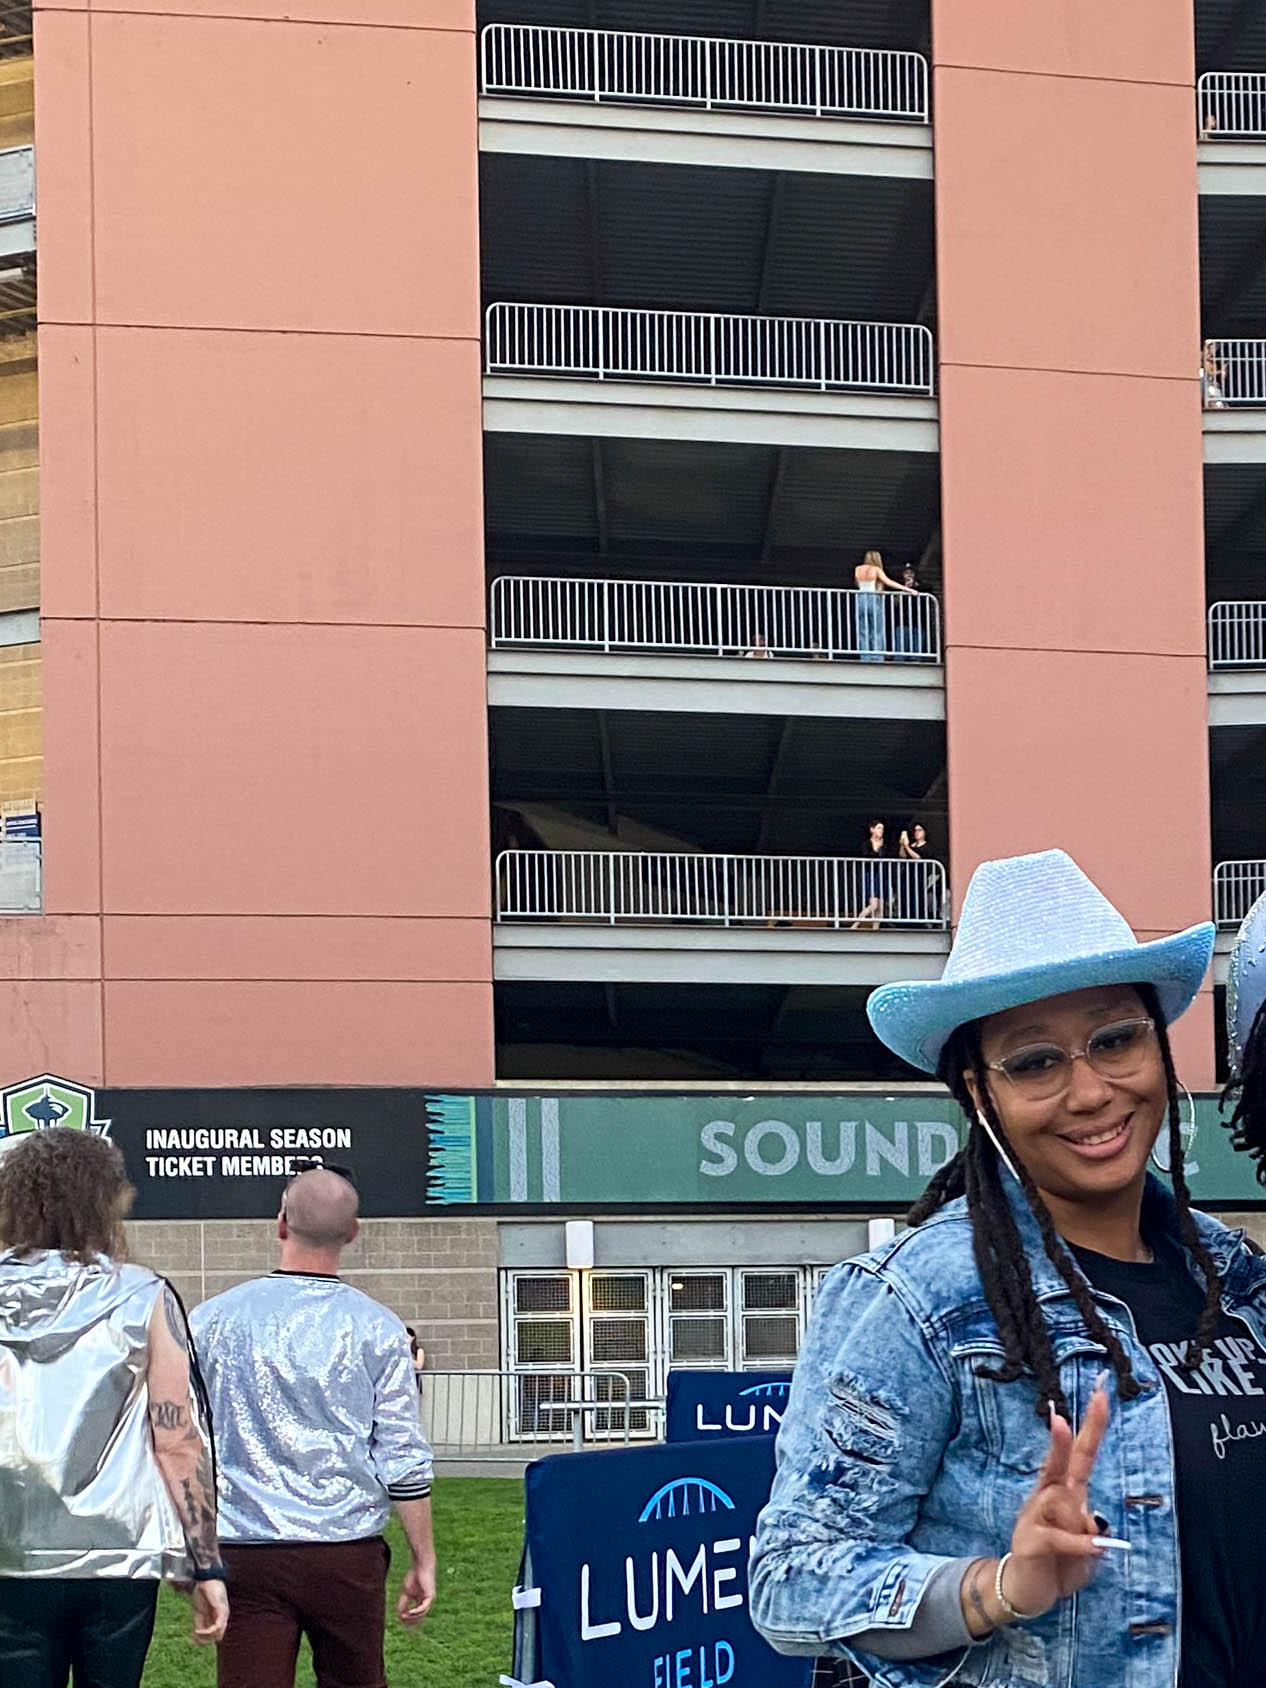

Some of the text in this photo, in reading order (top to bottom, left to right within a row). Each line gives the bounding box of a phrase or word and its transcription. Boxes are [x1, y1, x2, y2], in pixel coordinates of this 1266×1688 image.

[145, 1128, 351, 1149] INAUGURAL SEASON
[699, 1120, 959, 1177] SOUND
[145, 1156, 217, 1177] TICKET
[1213, 1336, 1257, 1365] UP
[1158, 1358, 1265, 1395] LIKE
[581, 1535, 758, 1641] LUME
